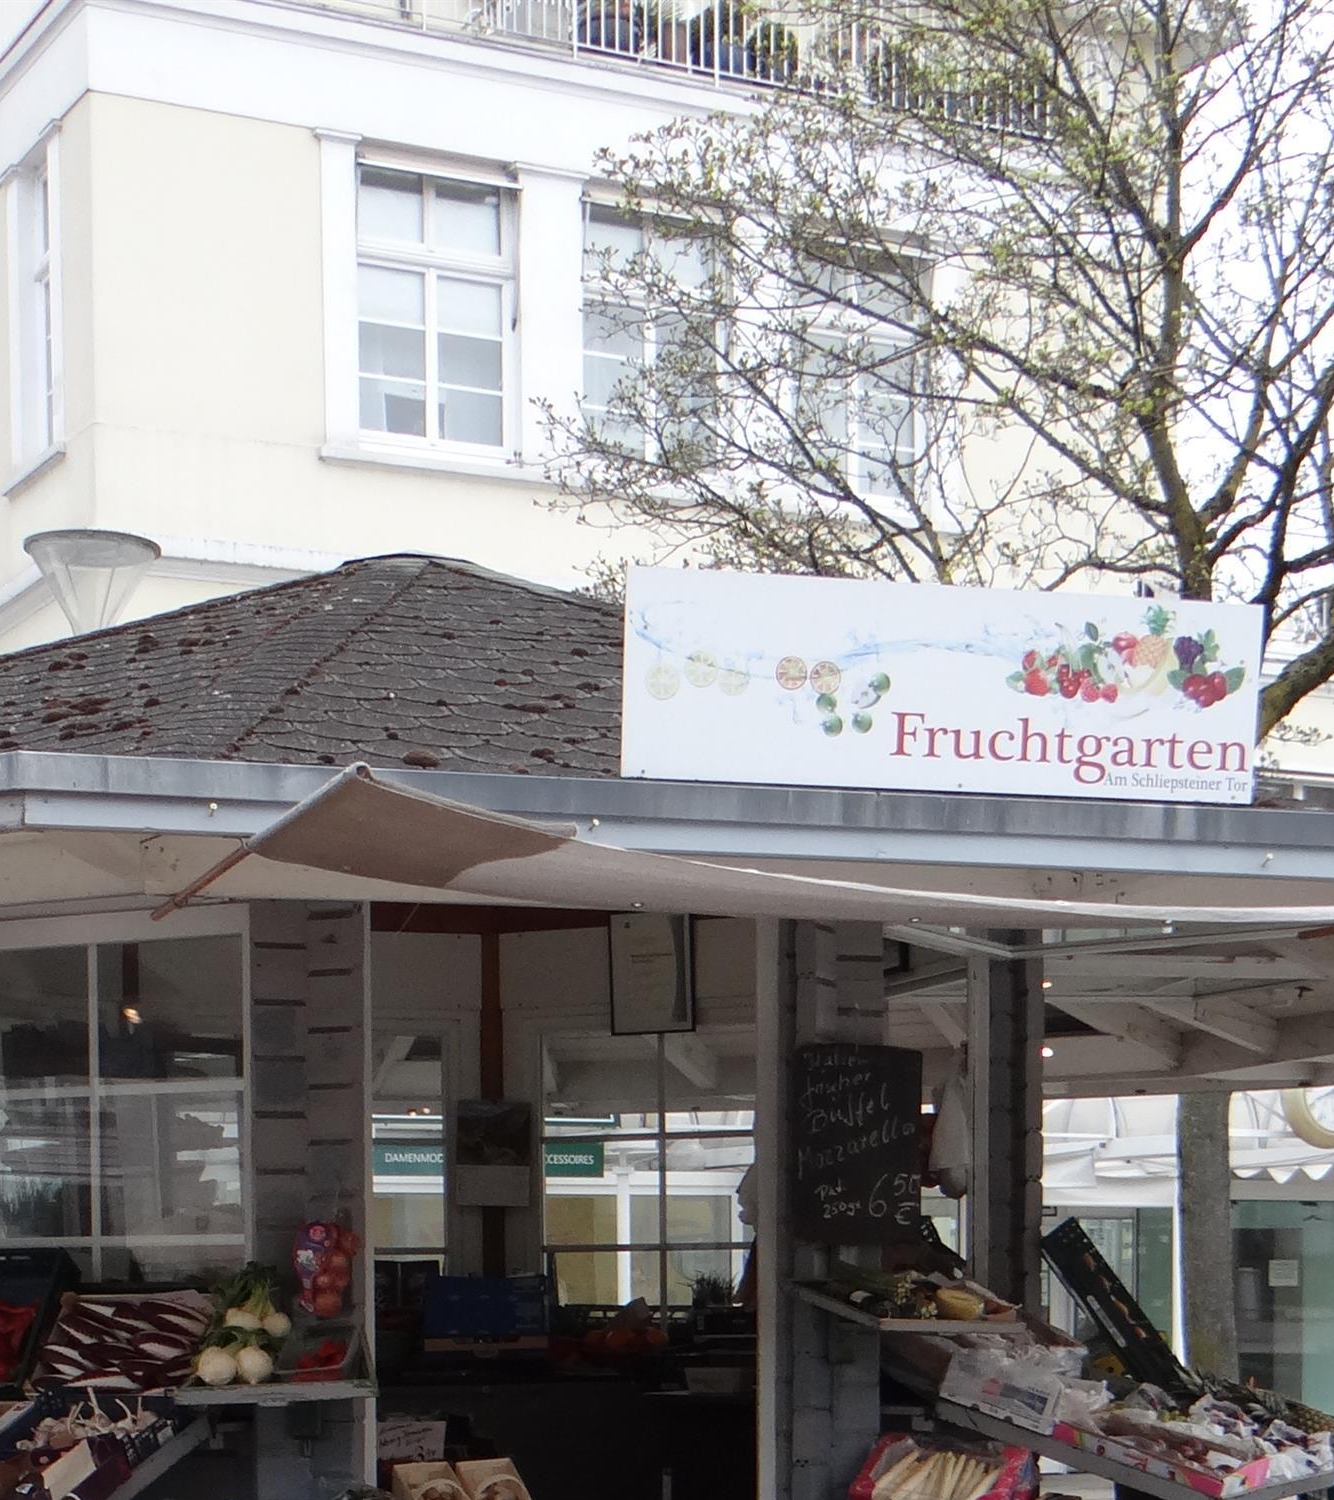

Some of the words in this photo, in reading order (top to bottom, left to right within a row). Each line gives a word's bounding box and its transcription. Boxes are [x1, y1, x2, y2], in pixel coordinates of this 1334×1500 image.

[888, 711, 1249, 785] Fruchtgarten
[1102, 773, 1128, 788] Am
[1131, 773, 1222, 792] Schliepsteiner
[1224, 778, 1248, 793] Tor
